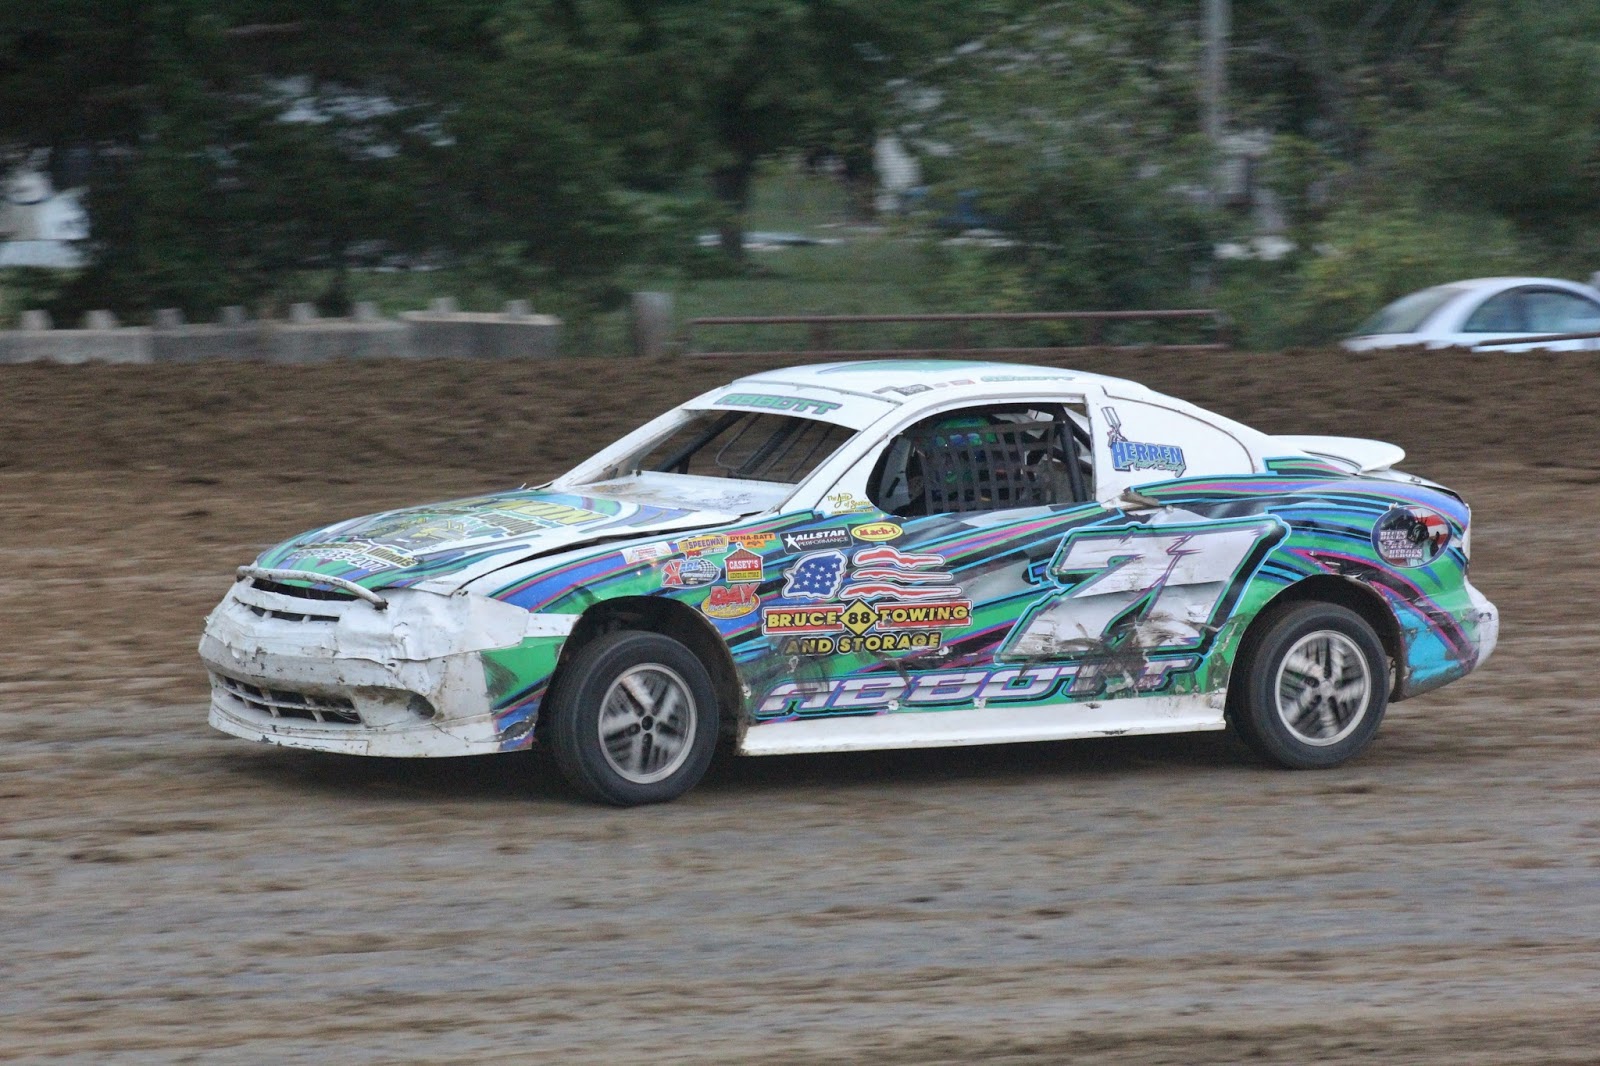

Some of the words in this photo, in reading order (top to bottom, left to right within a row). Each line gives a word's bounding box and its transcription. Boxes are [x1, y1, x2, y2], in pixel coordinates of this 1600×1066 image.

[713, 393, 843, 415] ABBOTT
[1111, 441, 1182, 469] HERREN
[729, 533, 774, 541] DYNA-BATT
[796, 529, 845, 541] ALLSTAR
[688, 537, 724, 549] SPEEDWAY
[798, 537, 849, 547] PERFORMANCE
[1389, 549, 1423, 558] HEROES
[729, 560, 759, 570] CASEY'S
[709, 582, 760, 605] DAY
[767, 610, 838, 628] BRUCE
[848, 611, 871, 625] 88
[879, 605, 969, 626] TOWING
[786, 637, 833, 655] AND
[839, 632, 941, 652] STORAGE
